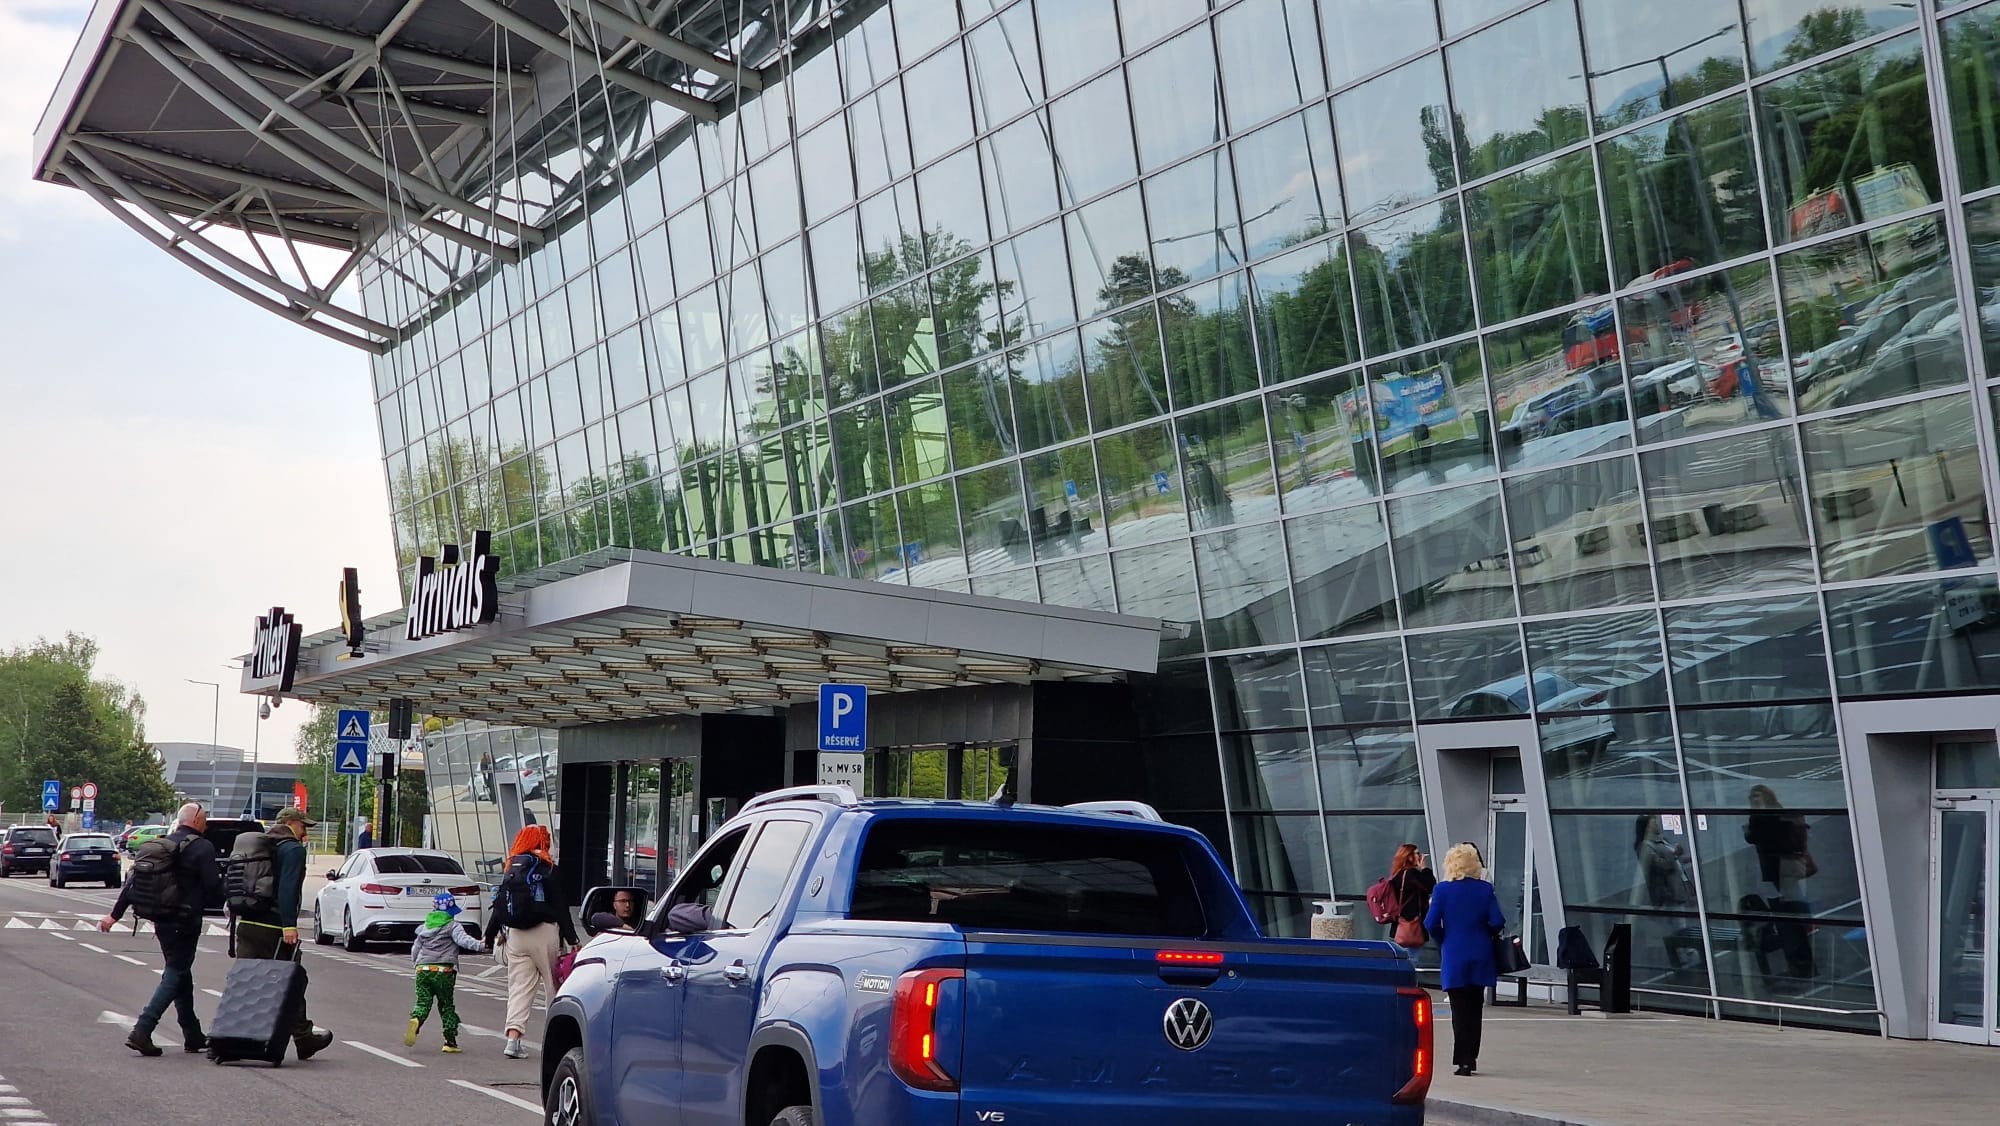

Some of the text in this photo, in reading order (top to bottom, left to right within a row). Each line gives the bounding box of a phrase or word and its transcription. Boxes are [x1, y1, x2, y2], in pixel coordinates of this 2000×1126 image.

[405, 530, 494, 640] Arrivals
[833, 693, 853, 728] P
[825, 734, 860, 747] RÉSERVÉ
[836, 763, 849, 773] MV
[851, 763, 863, 774] SR
[975, 1110, 1005, 1122] V6
